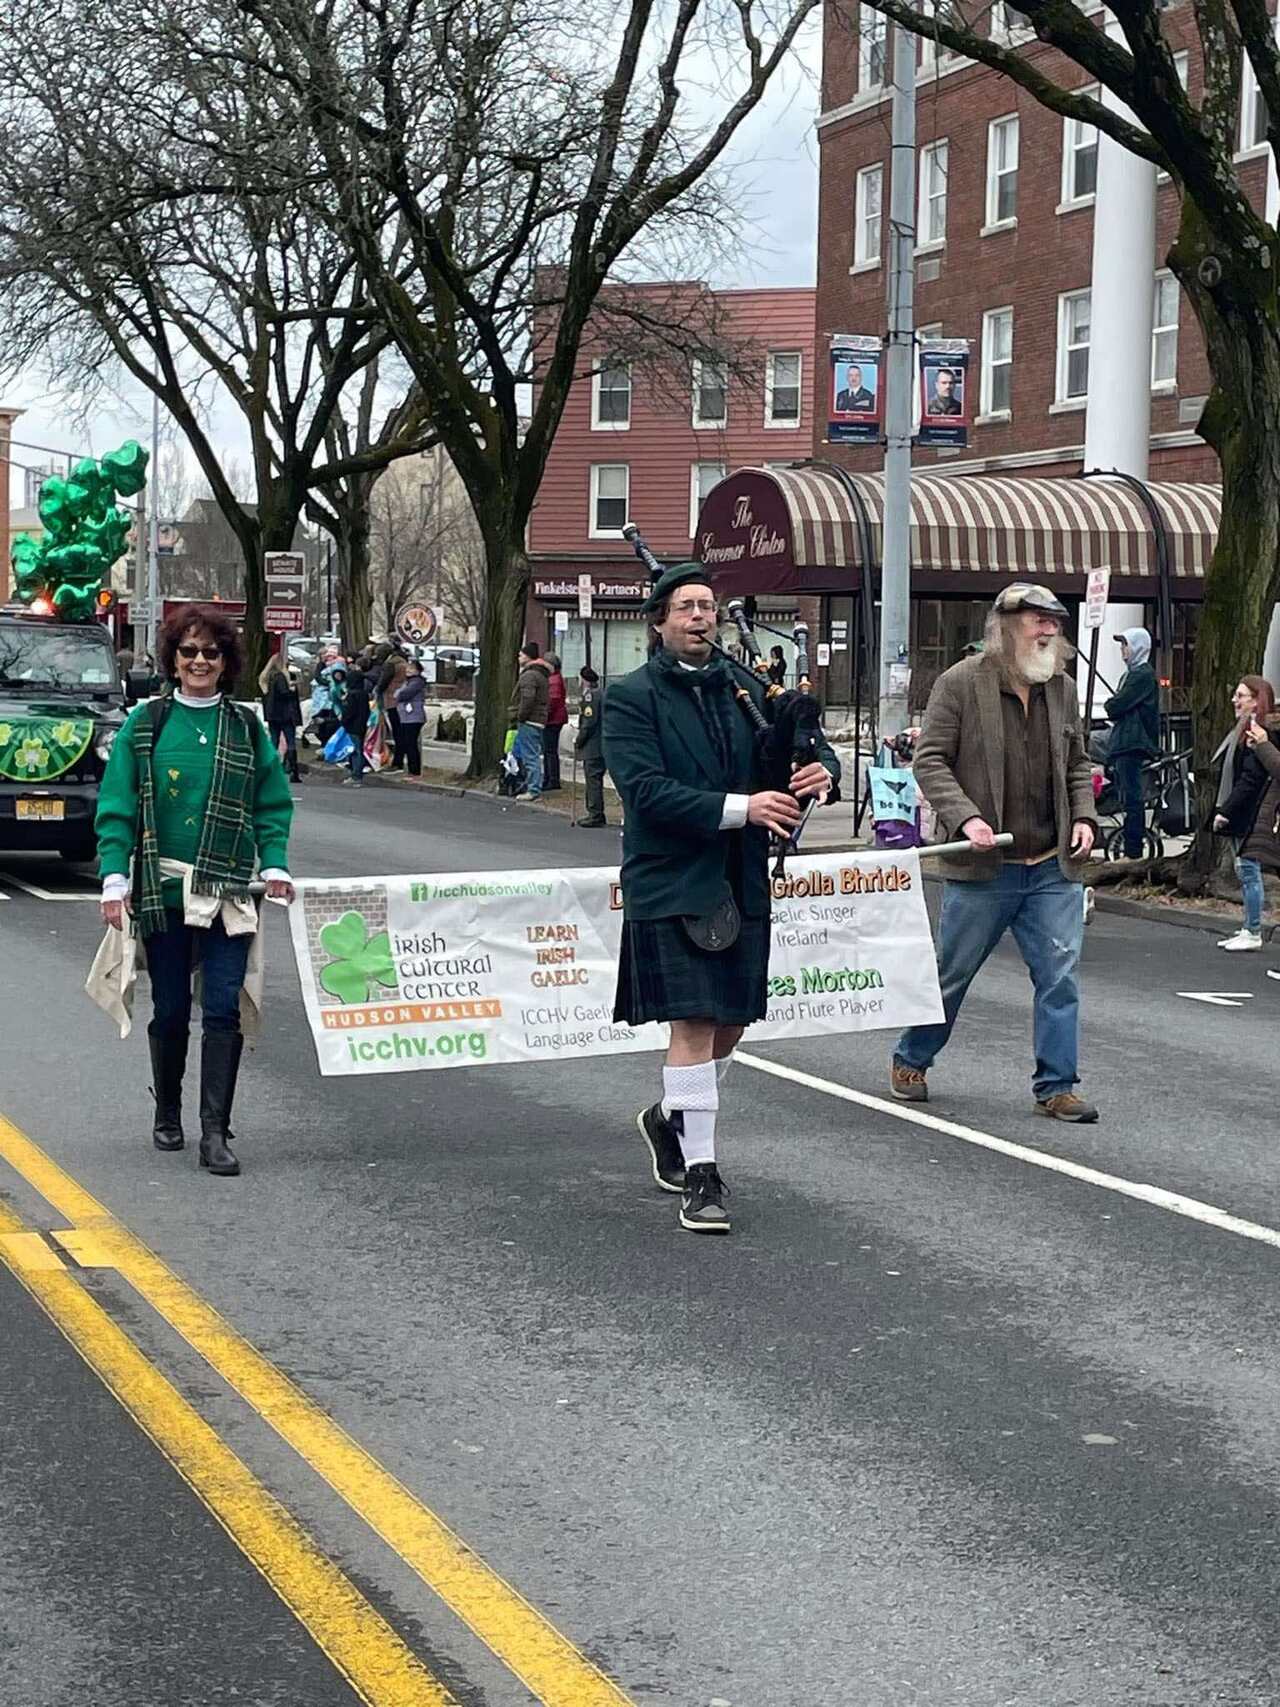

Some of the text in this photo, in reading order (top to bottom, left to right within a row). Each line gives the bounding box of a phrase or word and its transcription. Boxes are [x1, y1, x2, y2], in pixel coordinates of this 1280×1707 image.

[731, 496, 752, 528] The
[701, 524, 785, 563] Governor Clinton
[599, 582, 641, 595] Partners
[772, 865, 911, 899] Giolla Bhride
[770, 904, 856, 924] aelic Singer
[527, 924, 579, 943] LEARN
[776, 928, 828, 947] Ireland
[536, 947, 575, 965] IRISH
[530, 968, 589, 988] GAELIC
[800, 966, 884, 995] Morton
[326, 1003, 497, 1027] HUDSON VALLEY
[521, 1008, 568, 1025] ICCHV
[767, 998, 884, 1021] and Flute Player
[347, 1032, 486, 1062] icchv.org
[525, 1026, 636, 1049] Language Class
